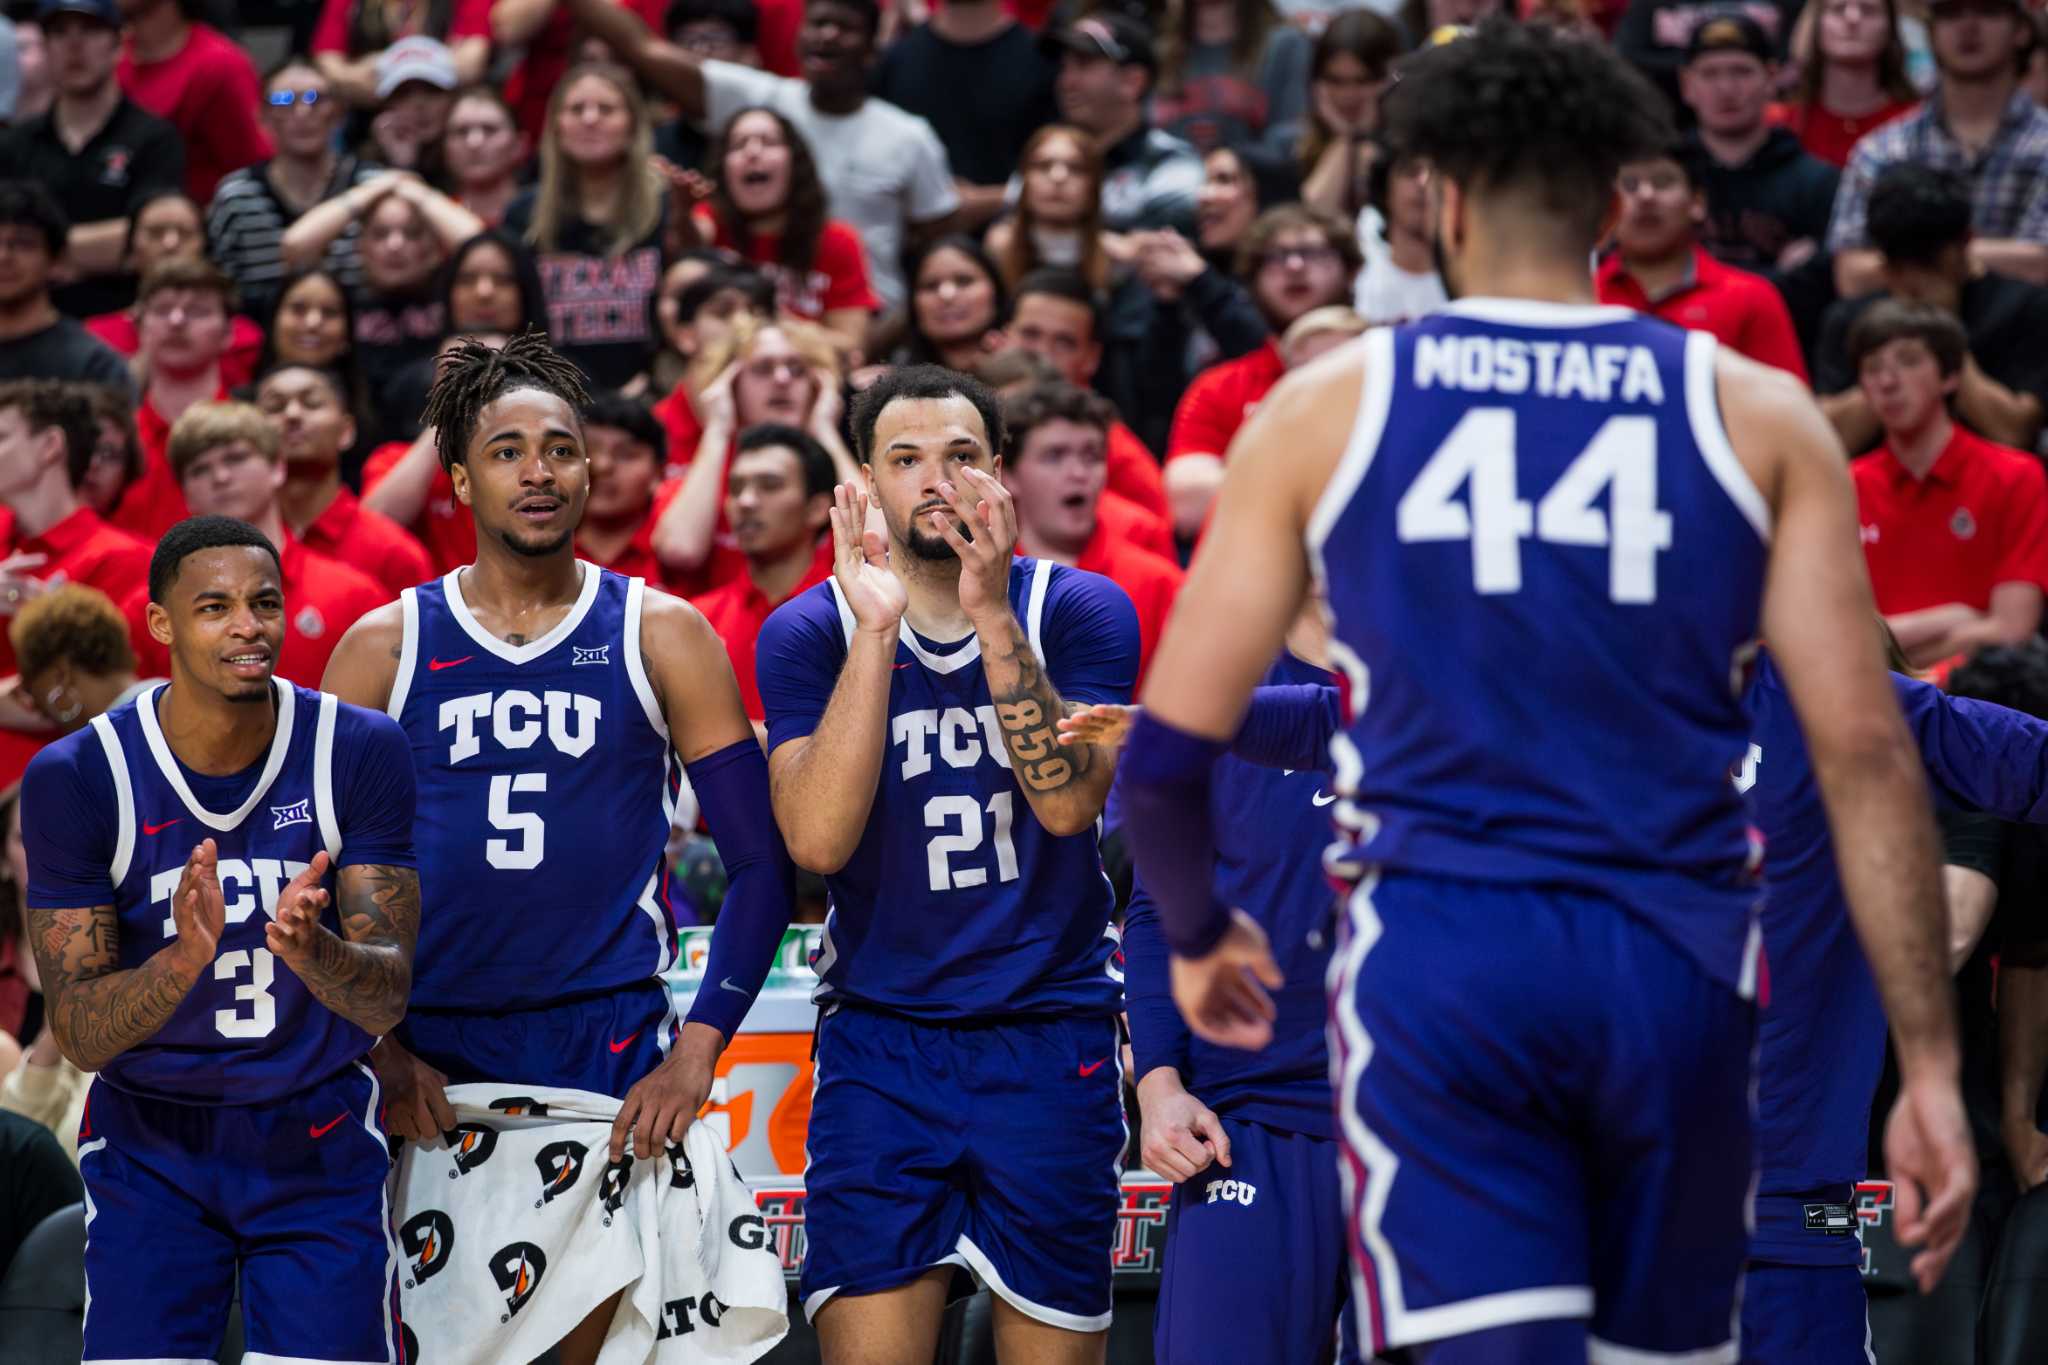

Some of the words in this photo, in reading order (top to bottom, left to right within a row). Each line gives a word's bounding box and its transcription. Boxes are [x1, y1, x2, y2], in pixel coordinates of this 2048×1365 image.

[540, 250, 659, 299] TEXAS
[548, 298, 645, 341] TECH
[1413, 335, 1664, 404] MOSTAFA
[1396, 406, 1673, 605] 44
[438, 689, 602, 765] TCU
[998, 699, 1072, 791] 859
[486, 773, 547, 870] 5
[924, 791, 1019, 890] 21
[214, 947, 276, 1038] 3
[1205, 1180, 1256, 1206] TCU
